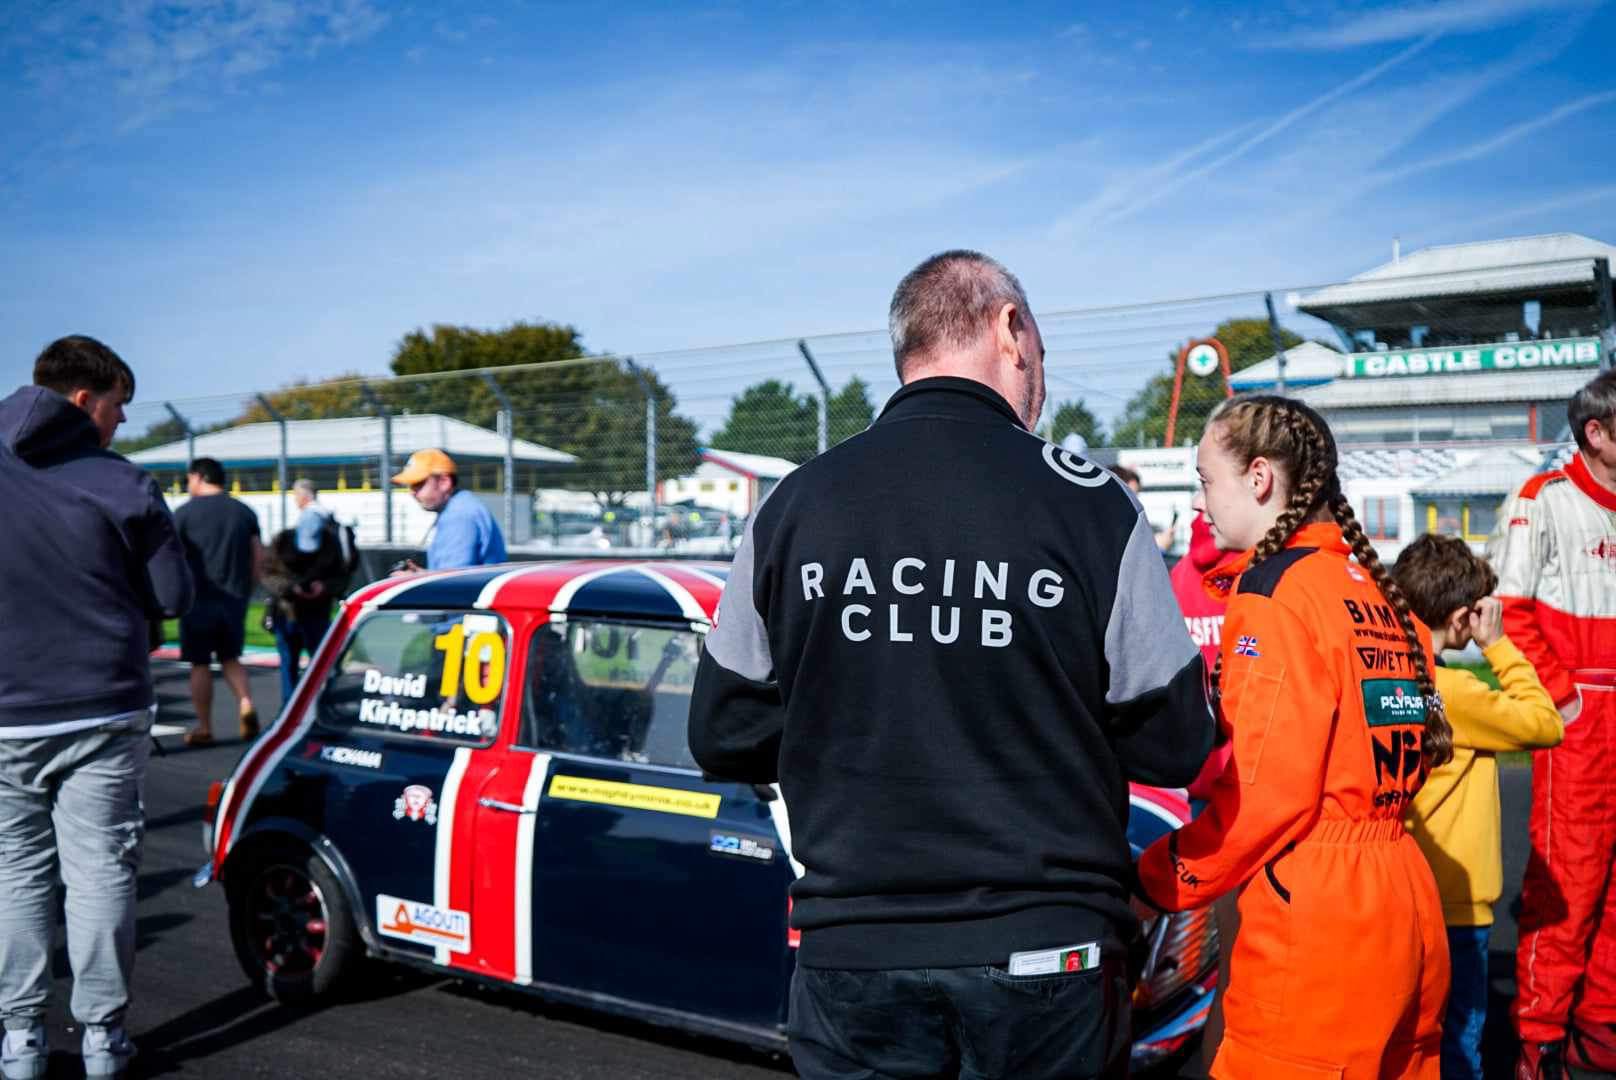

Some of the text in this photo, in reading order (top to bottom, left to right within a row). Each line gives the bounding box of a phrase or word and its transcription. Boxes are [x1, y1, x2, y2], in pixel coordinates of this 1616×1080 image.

[1365, 342, 1600, 376] CASTLE COMB
[801, 557, 1065, 608] RACING
[841, 603, 1014, 648] CLUB
[434, 623, 506, 704] 10
[363, 669, 427, 698] David
[359, 698, 481, 736] Kirkpatrick
[414, 907, 465, 935] AGOUTI
